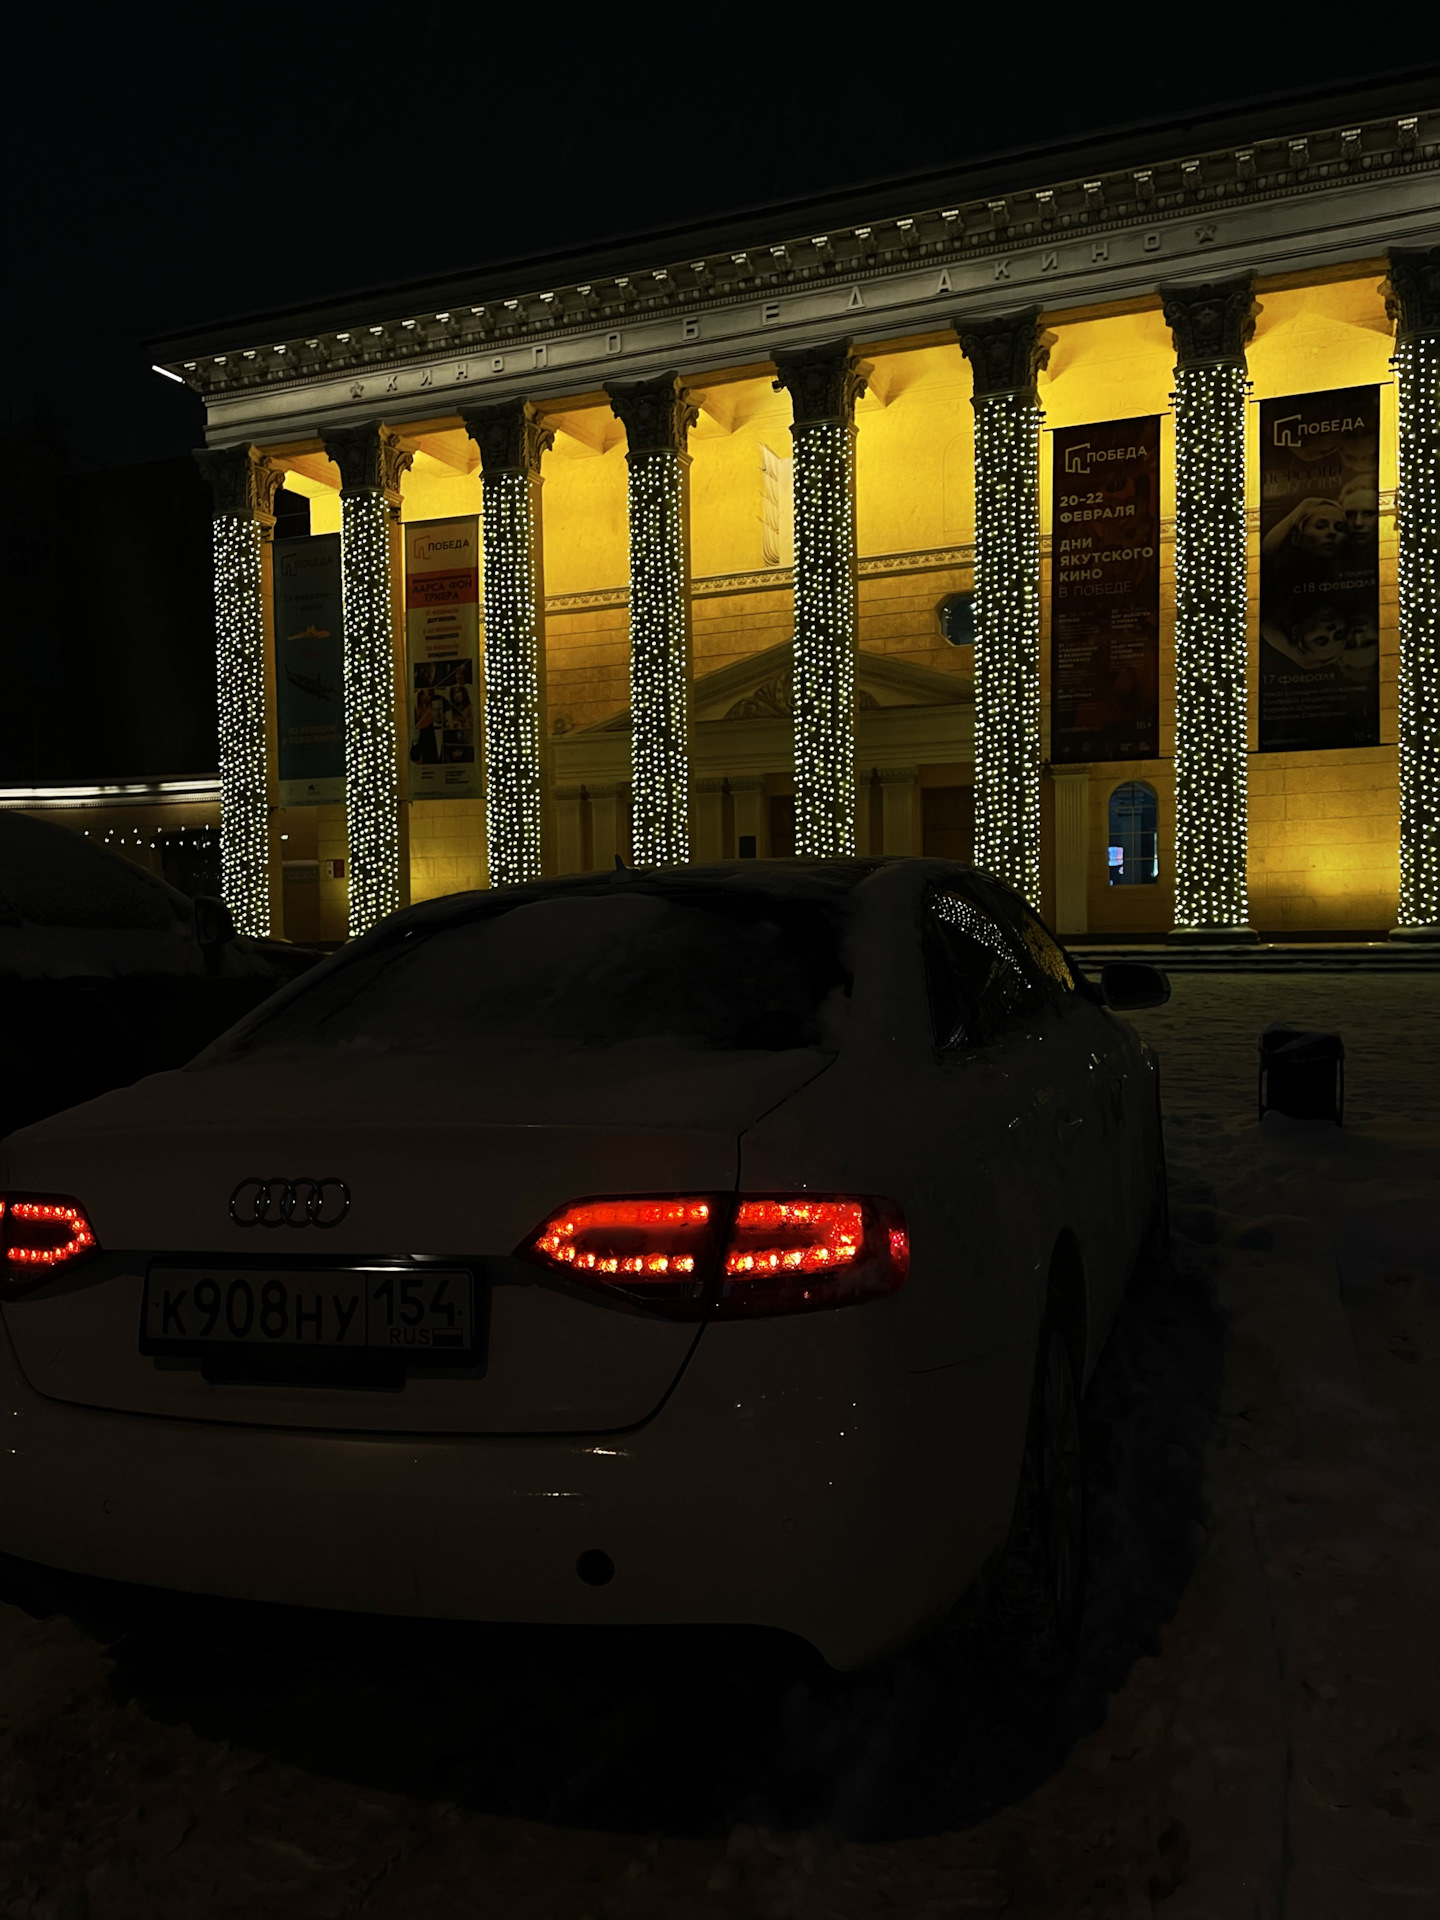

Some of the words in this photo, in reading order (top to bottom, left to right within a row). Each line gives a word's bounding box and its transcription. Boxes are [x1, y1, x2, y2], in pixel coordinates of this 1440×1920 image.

[1298, 417, 1365, 436] ПОБЕДА
[1086, 446, 1148, 463] ПОБЕДА
[1060, 504, 1135, 523] ФЕВРАЛЯ
[428, 539, 469, 552] ПОБЕДА
[1060, 537, 1092, 552] ДНИ
[1060, 547, 1154, 567] ЯКУТСКОГО
[1059, 568, 1103, 583] КИНО
[1059, 586, 1068, 599] В
[1073, 581, 1133, 597] ПОБЕДЕ
[161, 1278, 359, 1341] К908НУ
[372, 1278, 457, 1326] 154
[389, 1327, 430, 1345] RUS
